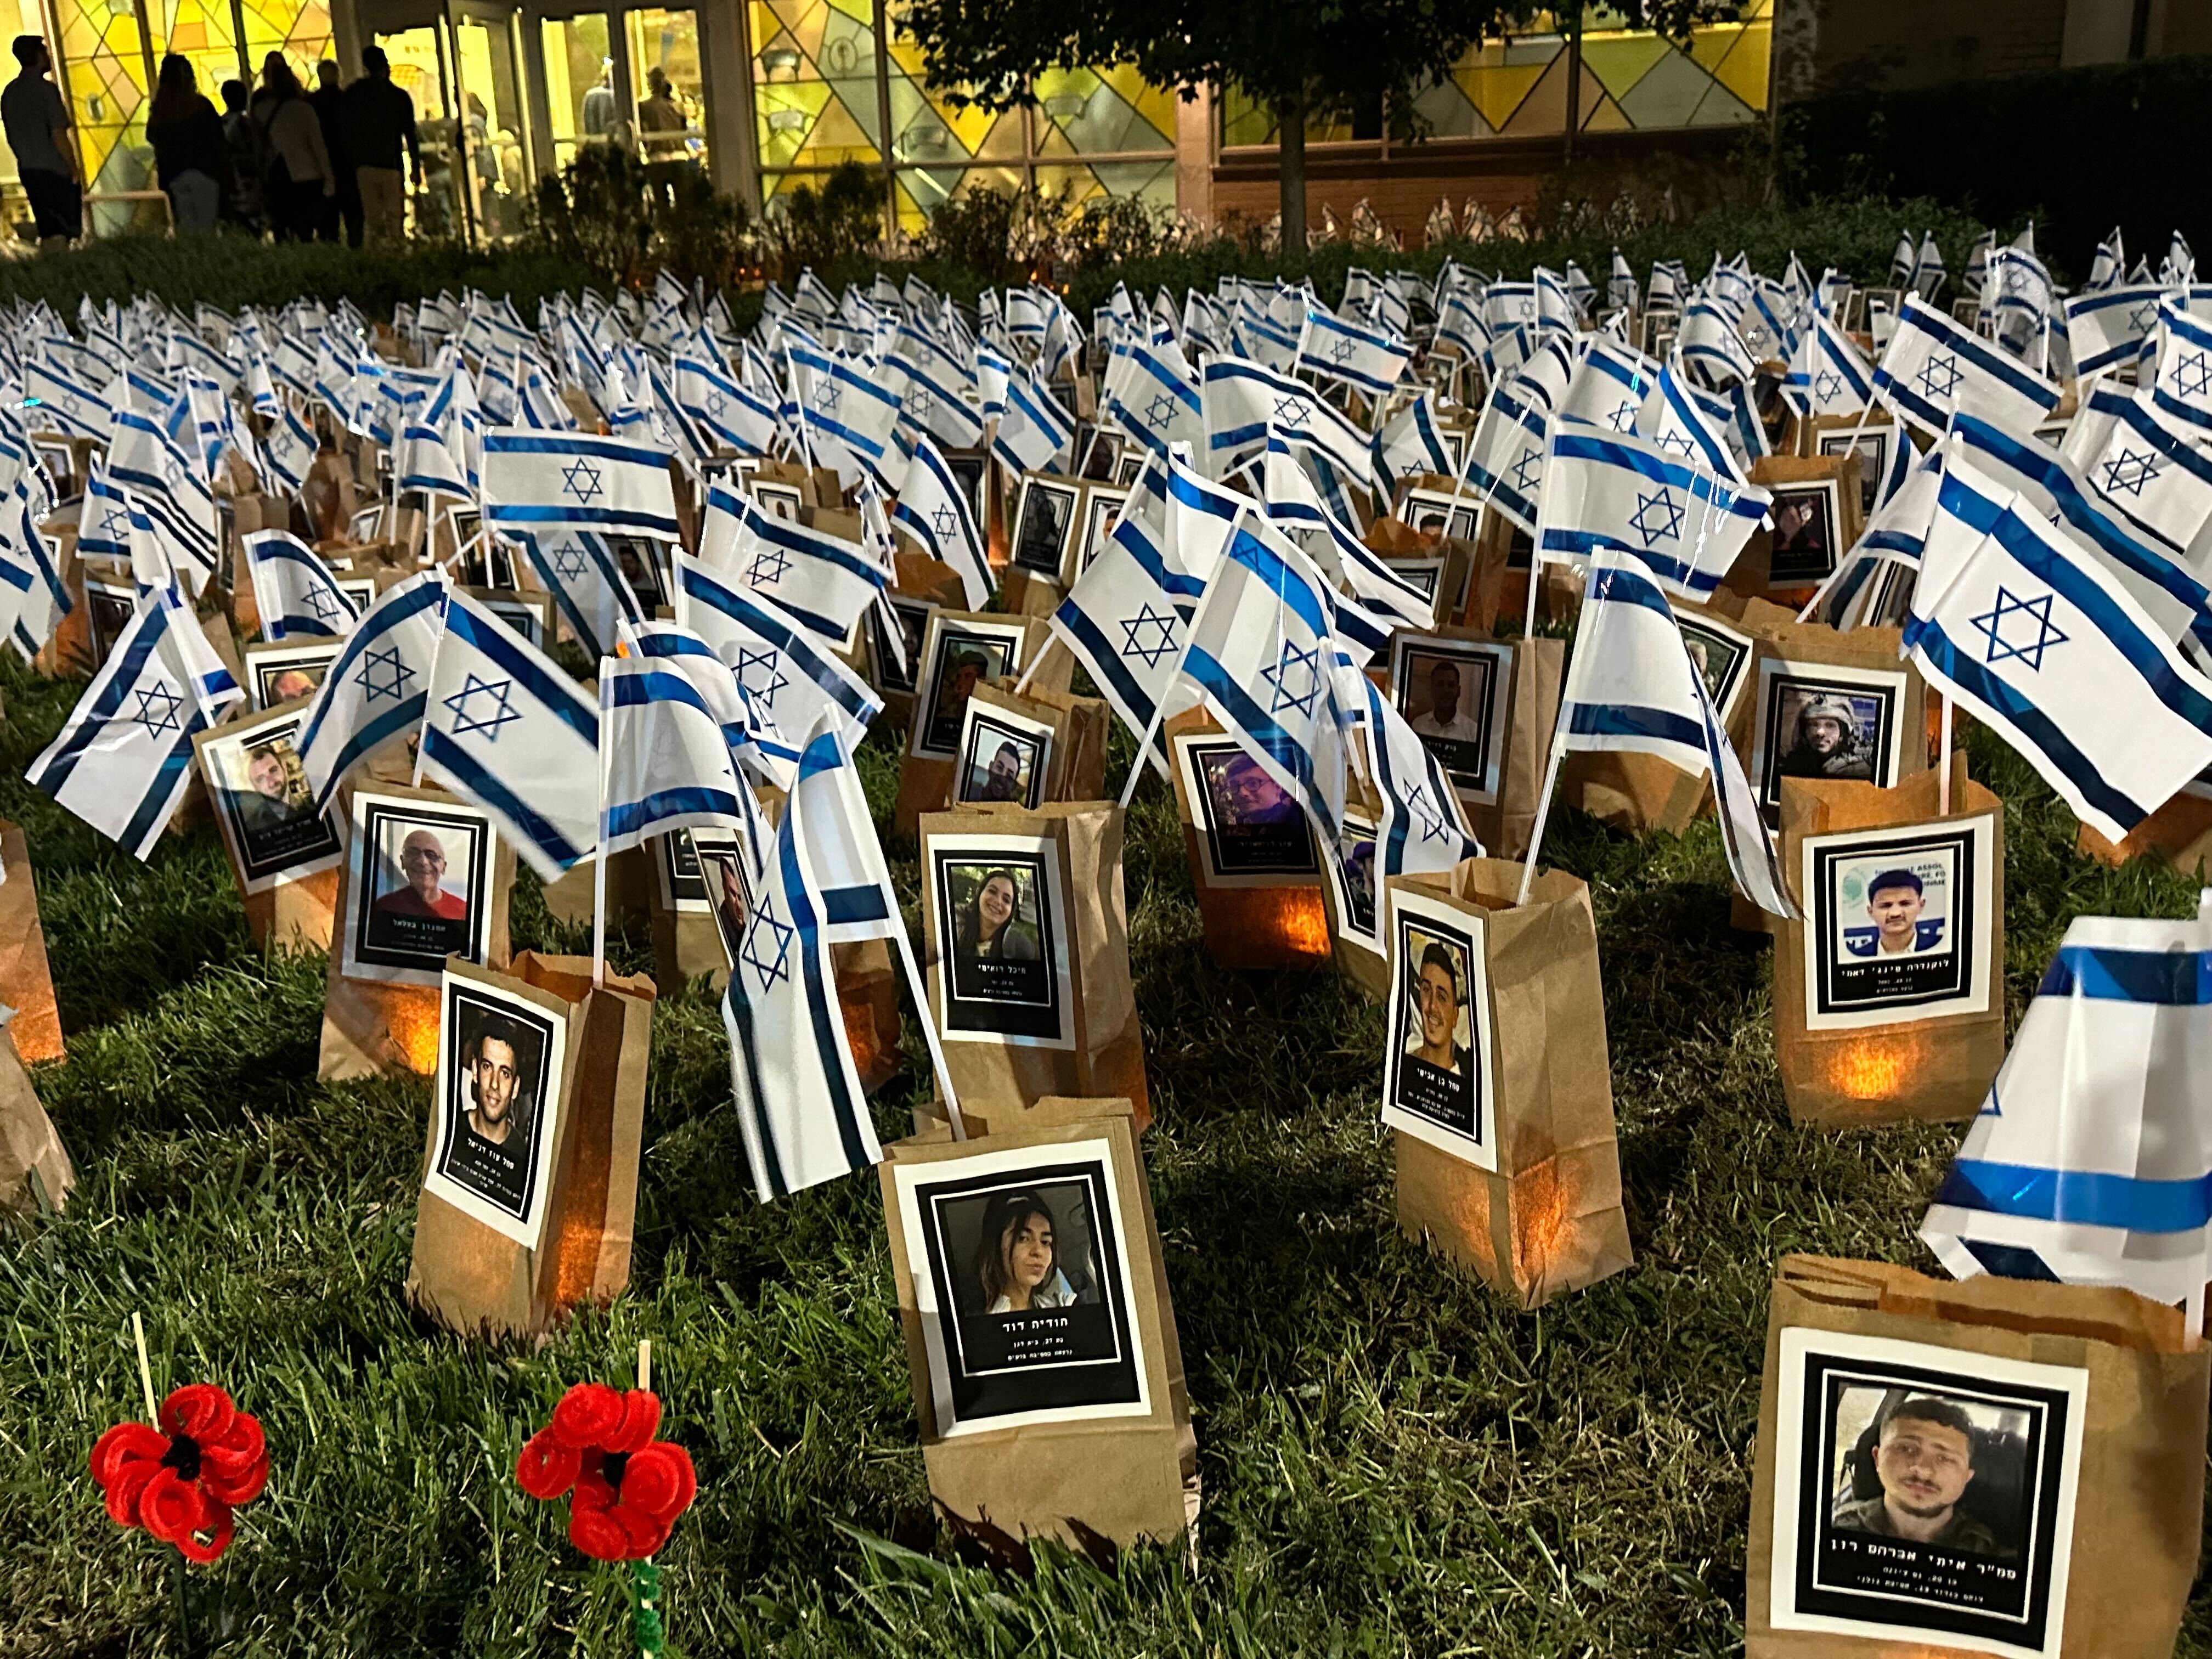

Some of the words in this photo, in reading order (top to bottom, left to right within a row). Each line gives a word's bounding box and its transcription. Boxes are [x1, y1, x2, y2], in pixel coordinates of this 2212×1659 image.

[1007, 965, 1026, 974] מיכל
[1002, 1322, 1025, 1332] דוד
[1831, 1539, 1858, 1551] רון
[1868, 1544, 1916, 1561] אברהם
[1928, 1555, 1966, 1570] איתי
